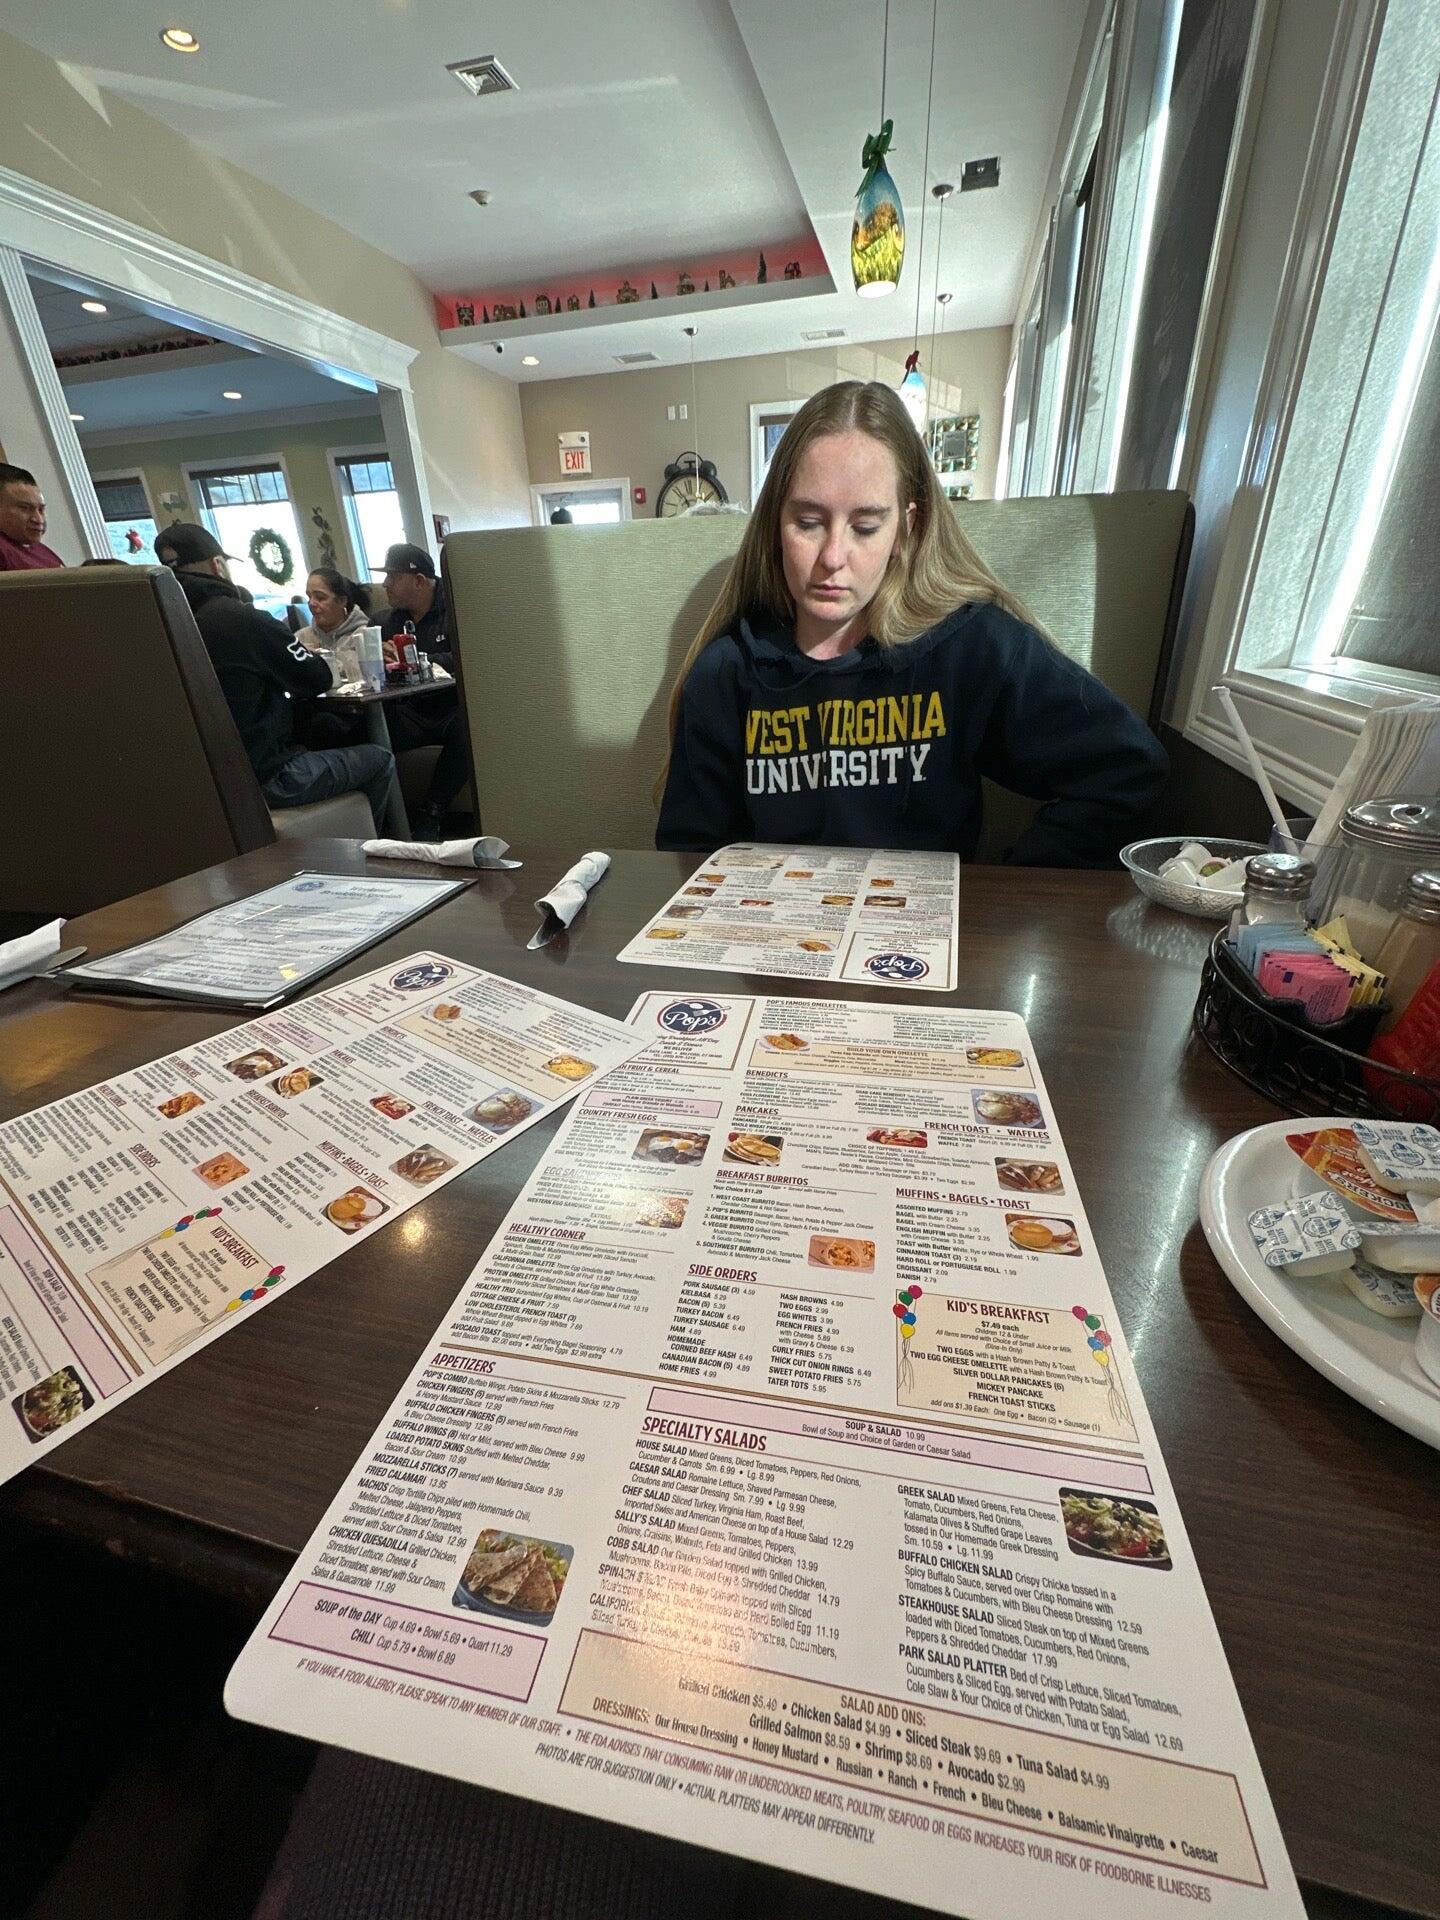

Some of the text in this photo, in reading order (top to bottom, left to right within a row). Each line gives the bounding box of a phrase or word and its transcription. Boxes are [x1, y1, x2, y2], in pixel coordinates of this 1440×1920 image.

[565, 451, 584, 470] EXIT
[818, 691, 946, 746] VIRGINIA
[666, 1012, 718, 1030] Pop's
[746, 1070, 788, 1079] BENEDICTS
[579, 1109, 657, 1121] COUNTRY FRESH EGGS
[736, 1106, 779, 1115] PANCAKES
[925, 1122, 1050, 1139] FRENCH TOAST WAFFLES
[717, 1169, 809, 1186] BREAKFAST BURRITOS
[896, 1188, 1030, 1210] MUFFINS BAGELS TOAST
[509, 1223, 586, 1240] HEALTHY CORNER
[688, 1263, 757, 1282] SIDE ORDERS
[896, 1263, 932, 1274] CROISSANT
[896, 1274, 921, 1282] DANISH
[780, 1292, 798, 1301] HASH
[799, 1295, 827, 1305] BROWNS
[947, 1300, 1050, 1324] KID'S BREAKFAST
[431, 1353, 496, 1373] APPETIZERS
[771, 1355, 791, 1365] THICK
[793, 1359, 806, 1368] CUT
[808, 1361, 830, 1371] ONION
[832, 1365, 854, 1374] RINGS
[768, 1376, 789, 1387] TATER
[790, 1380, 809, 1390] TOTS
[953, 1367, 979, 1379] SILVER
[980, 1371, 1010, 1385] DOLLAR
[1011, 1375, 1052, 1389] PANCAKES
[643, 1416, 767, 1451] SPECIALTY SALADS
[636, 1439, 687, 1456] HOUSE SALAD
[365, 1465, 388, 1479] FRIED
[388, 1469, 427, 1485] CALAMARI
[630, 1461, 687, 1480] CAESAR SALAD
[622, 1485, 670, 1502] CHEF SALAD
[898, 1484, 955, 1503] GREEK SALAD
[329, 1525, 409, 1552] CHICKEN QUESADILLA
[899, 1550, 1013, 1581] BUFFALO CHICKEN SALAD
[899, 1594, 994, 1624] STEAKHOUSE SALAD
[315, 1599, 338, 1613] SOUP
[338, 1606, 348, 1616] of
[350, 1608, 362, 1620] the
[363, 1611, 382, 1624] DAY
[383, 1616, 398, 1630] Cup
[399, 1620, 417, 1633] 4.69
[423, 1626, 442, 1640] Bowl
[443, 1631, 461, 1644] 5.69
[468, 1636, 489, 1651] Quart
[351, 1628, 455, 1664] CHILI Cup 5.79 Bowl 6.89
[899, 1644, 1007, 1679] PARK SALAD PLATTER
[305, 1660, 321, 1673] YOU
[320, 1663, 340, 1678] HAVE
[344, 1670, 366, 1684] FOOD
[363, 1675, 397, 1694] ALLERGY,
[396, 1683, 425, 1700] PLEASE
[426, 1690, 449, 1705] SPEAK
[448, 1696, 459, 1708] TO
[457, 1699, 475, 1714] ANY
[475, 1705, 509, 1722] MEMBER
[509, 1713, 521, 1724] OF
[520, 1715, 537, 1729] OUR
[537, 1720, 562, 1736] STAFF.
[841, 1695, 926, 1727] SALAD ADD ONS:
[712, 1685, 750, 1705] Chicken
[791, 1702, 831, 1724] Chicken
[834, 1714, 863, 1731] Salad
[865, 1721, 891, 1737] $4.99
[906, 1729, 938, 1750] Sliced
[941, 1737, 971, 1758] Steak
[1016, 1754, 1043, 1773] Tuna
[1046, 1762, 1079, 1783] Salad
[1081, 1771, 1110, 1790] $4.99
[749, 1713, 781, 1734] Grilled
[784, 1724, 822, 1744] Salmon
[865, 1742, 902, 1763] Shrimp
[948, 1761, 995, 1785] Avocado
[997, 1774, 1025, 1793] $2.99
[593, 1697, 1219, 1864] DRESSINGS: Our House Dressing Honey Mustard Russian Ranch French Bleu Cheese Balsamic Vinaigrette Caesar
